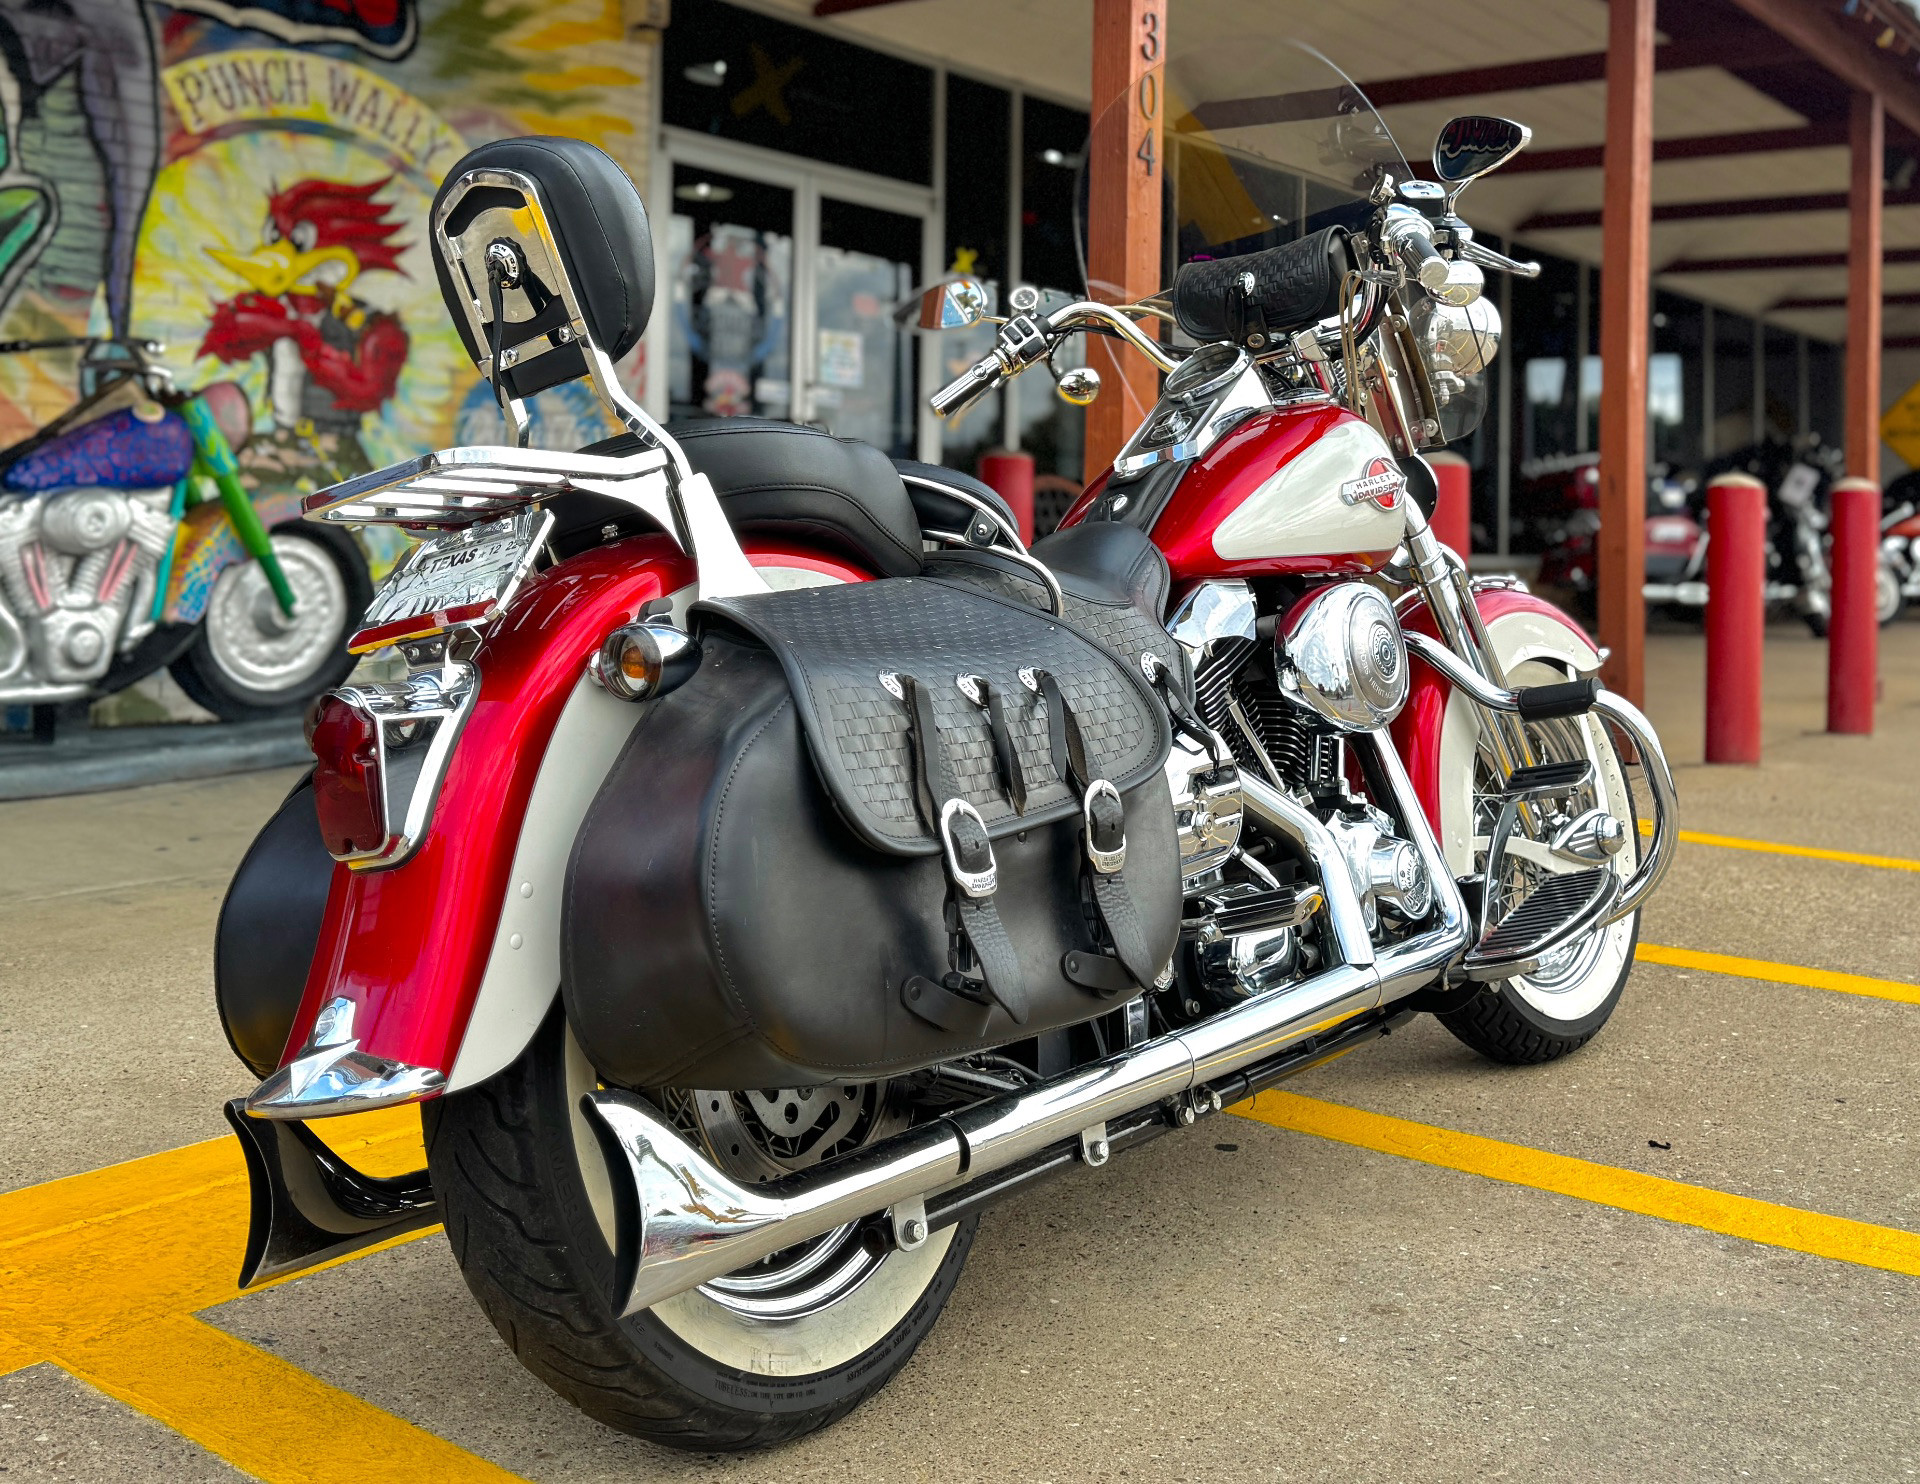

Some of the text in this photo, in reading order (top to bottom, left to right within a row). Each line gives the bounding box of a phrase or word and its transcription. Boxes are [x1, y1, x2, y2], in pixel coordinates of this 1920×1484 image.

[176, 57, 452, 163] PUNCH WALLY
[1138, 12, 1158, 176] 304
[1357, 481, 1399, 499] DAVIDSON
[429, 548, 479, 574] TEXAS
[488, 545, 502, 556] 12
